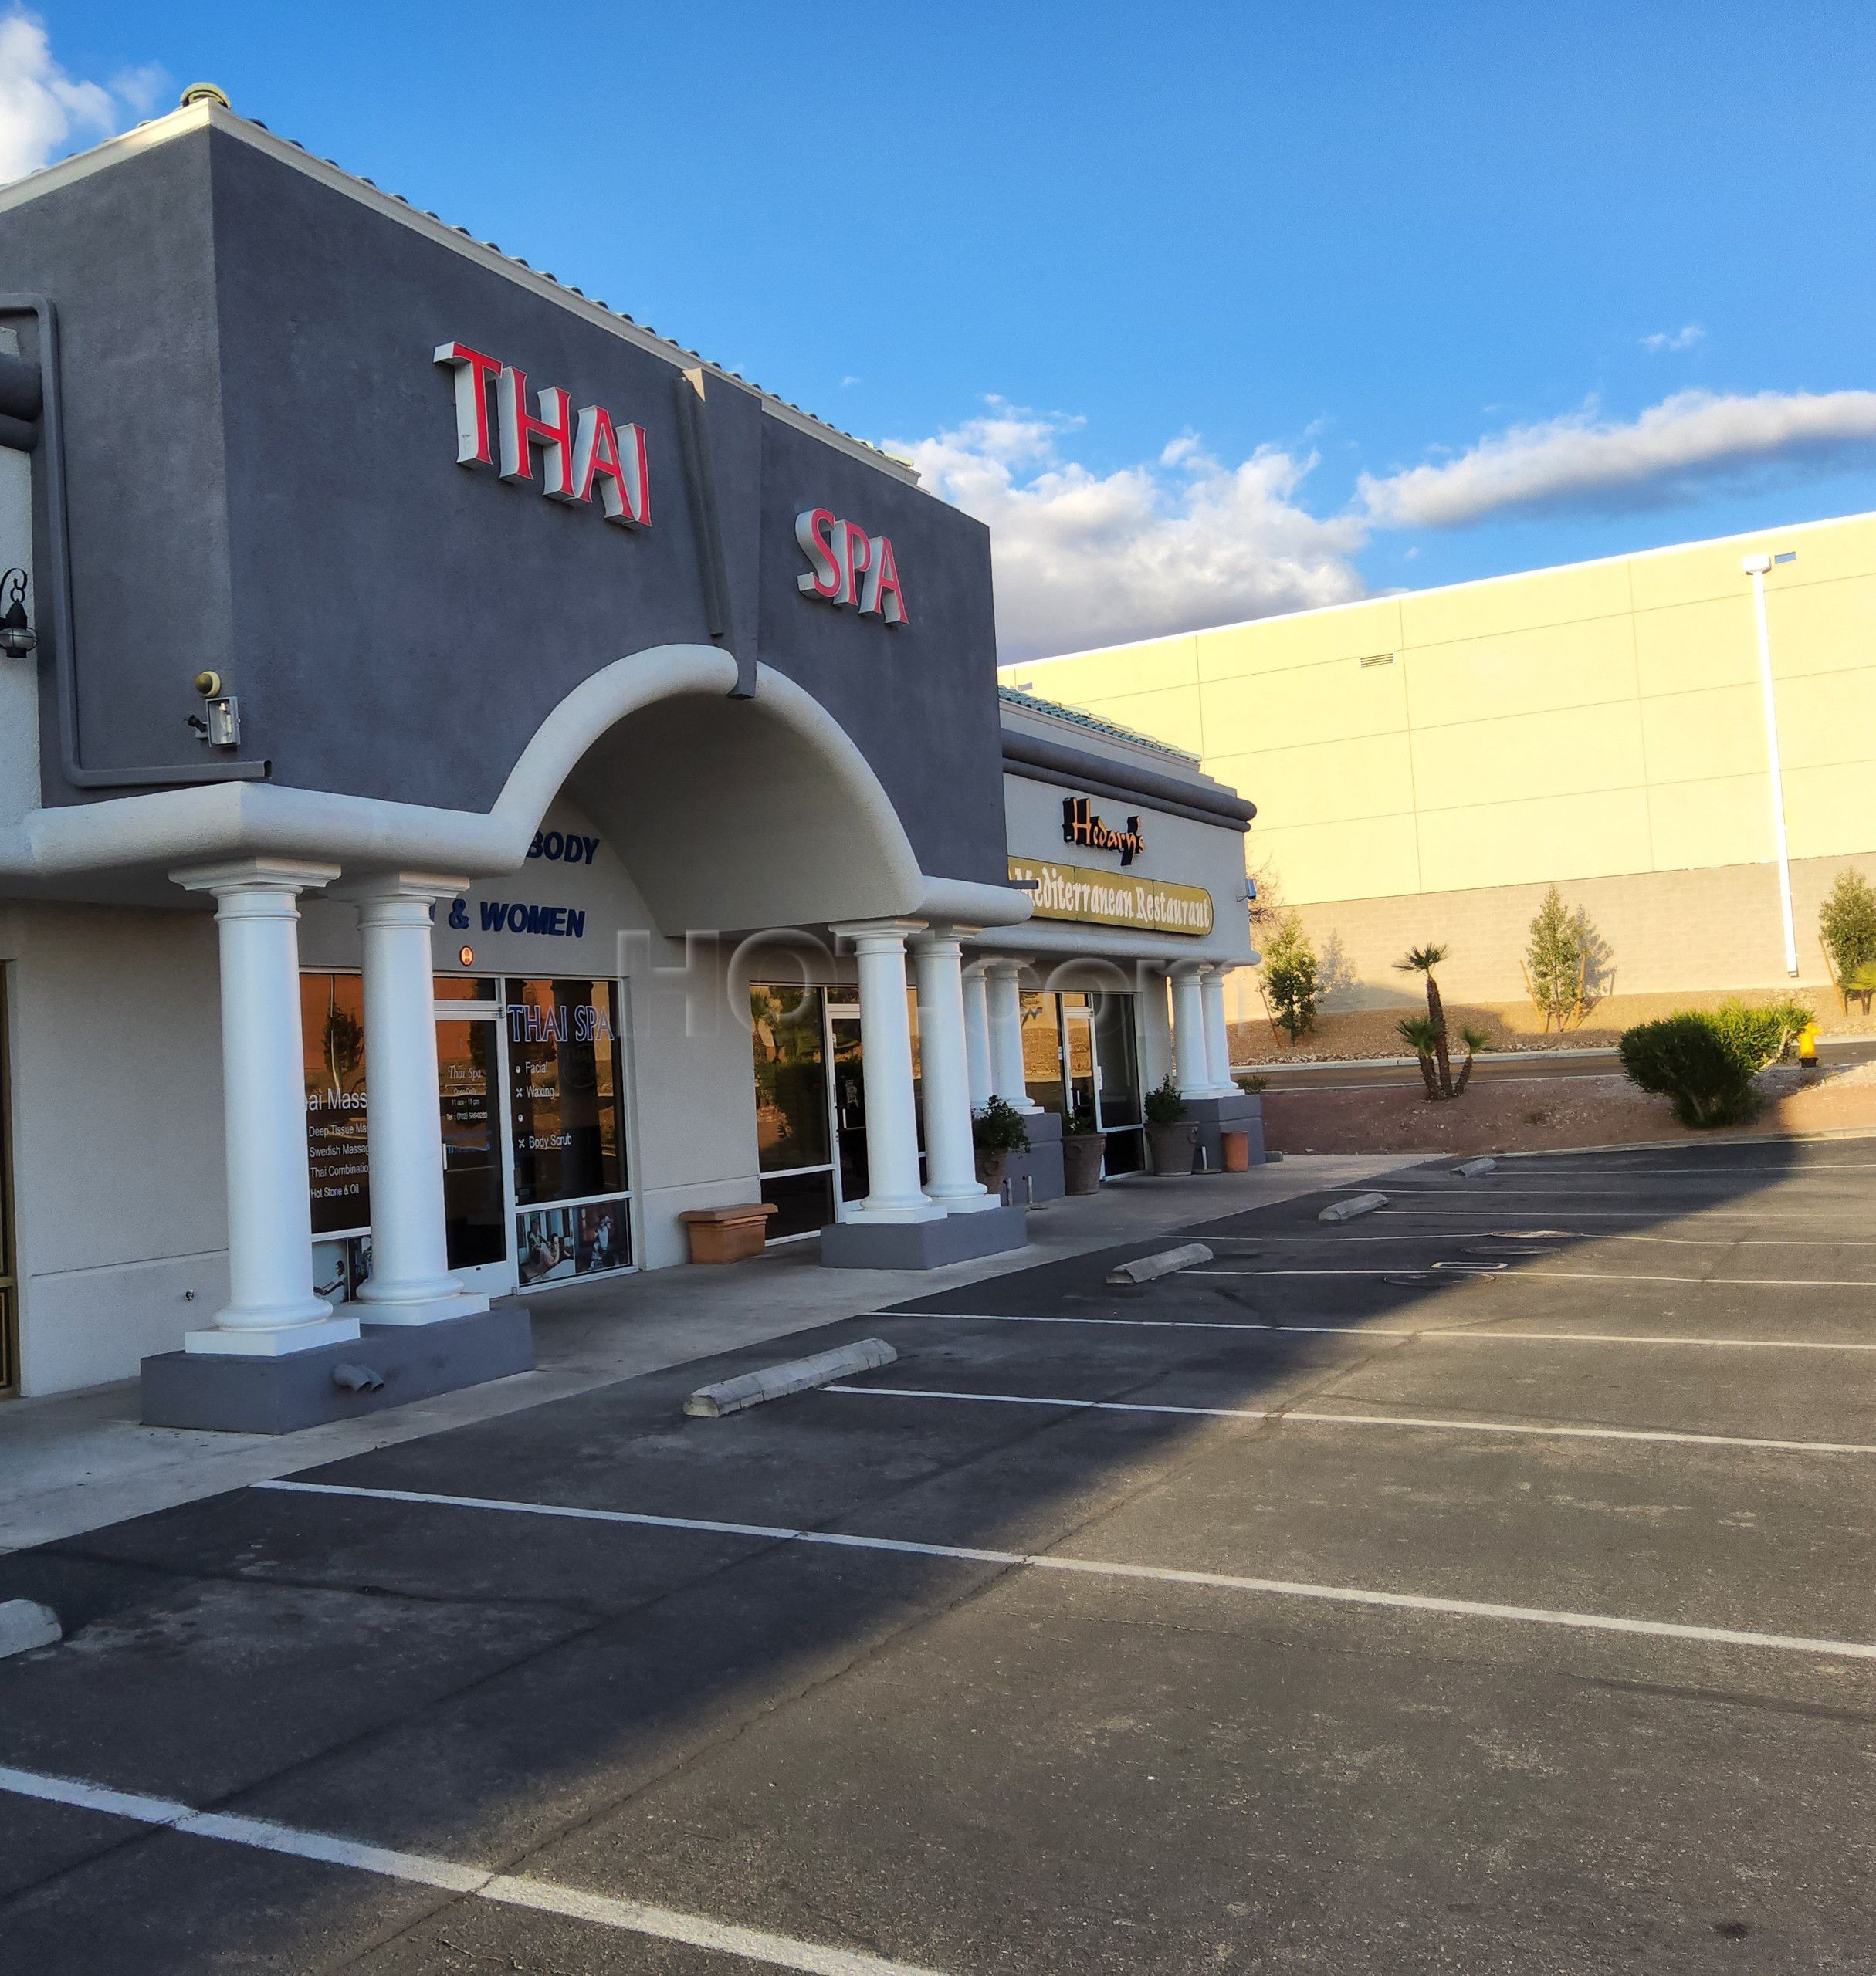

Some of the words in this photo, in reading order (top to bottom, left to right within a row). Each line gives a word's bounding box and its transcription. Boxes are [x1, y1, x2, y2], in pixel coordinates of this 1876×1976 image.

[433, 341, 652, 528] THAI
[794, 507, 909, 624] SPA
[527, 831, 600, 864] BODY
[1014, 867, 1133, 919] Mediterranean
[1135, 887, 1210, 928] Restaurant
[449, 898, 469, 929] &
[480, 901, 585, 938] WOMEN
[507, 1003, 568, 1042] THAI
[574, 1004, 615, 1042] SPA
[448, 1065, 465, 1078] Thai
[469, 1068, 483, 1081] Spa
[526, 1061, 548, 1074] Facial
[305, 1089, 322, 1112] ai
[327, 1088, 367, 1111] Mass
[526, 1086, 554, 1099] Waxing
[309, 1126, 328, 1139] Deep
[330, 1124, 354, 1136] Tissue
[356, 1123, 367, 1134] Ma
[310, 1145, 340, 1158] Swedish
[342, 1144, 369, 1156] Massag
[529, 1136, 549, 1151] Body
[550, 1133, 572, 1146] Scrub
[310, 1166, 327, 1178] Thai
[328, 1163, 368, 1176] Combinatio
[311, 1188, 323, 1199] Hot
[323, 1186, 343, 1198] Stone
[344, 1185, 349, 1195] &
[350, 1183, 360, 1194] Oil
